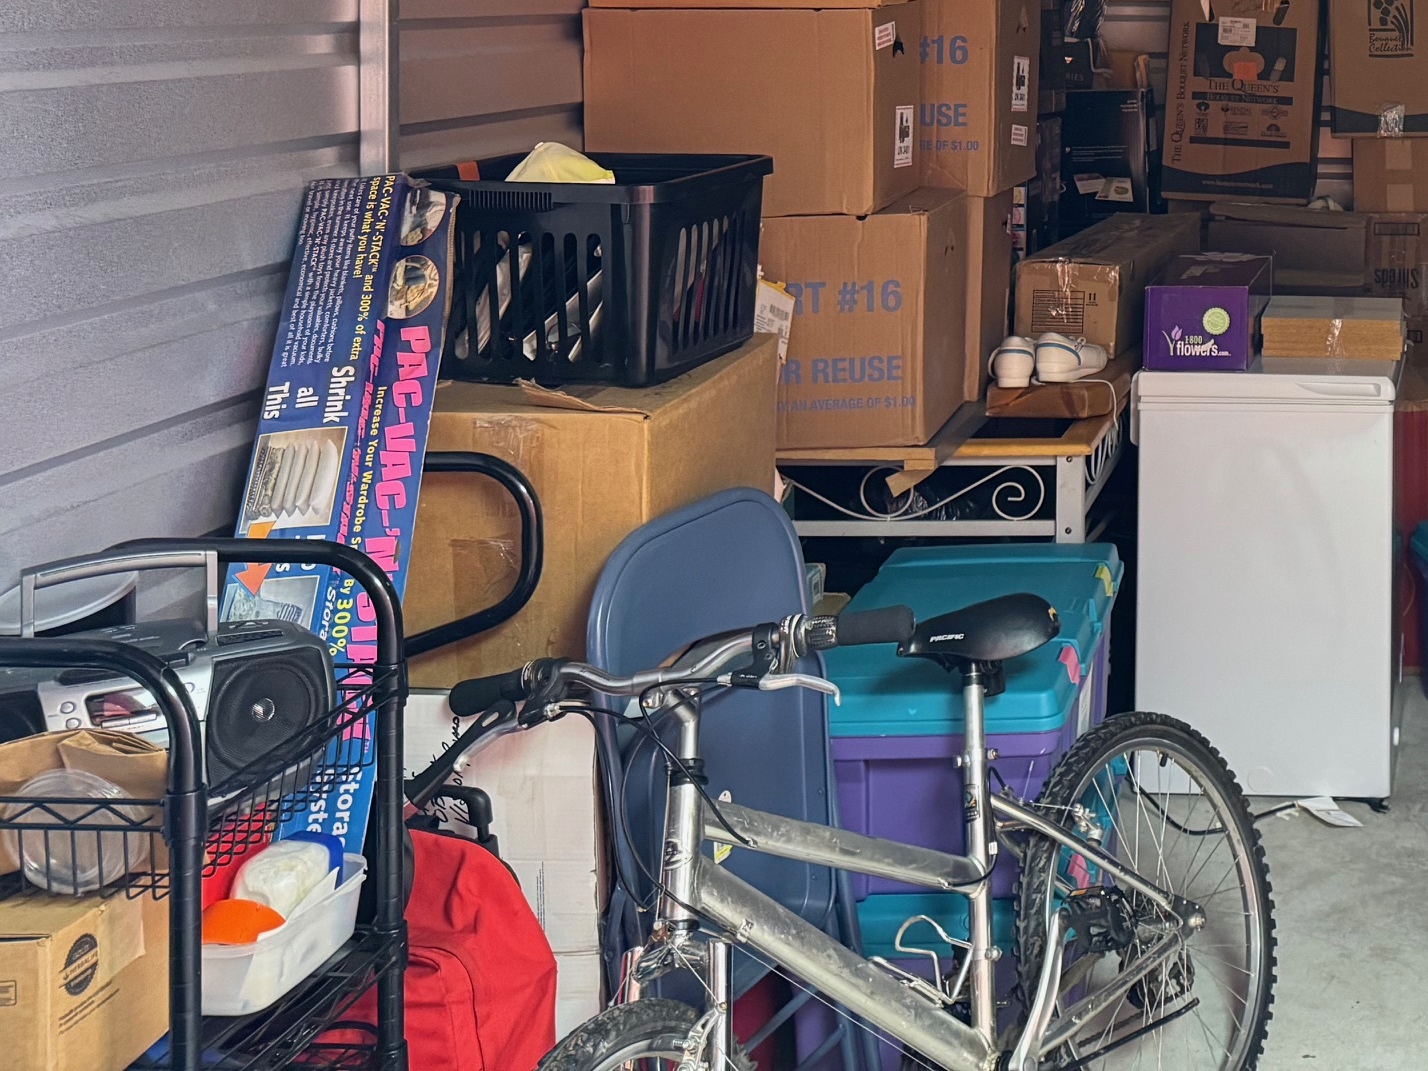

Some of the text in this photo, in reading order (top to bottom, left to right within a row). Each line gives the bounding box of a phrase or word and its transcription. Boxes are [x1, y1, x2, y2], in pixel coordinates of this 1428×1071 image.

[1171, 21, 1190, 164] THE QUEEN'S BOUQUET NETWORK
[1208, 78, 1279, 95] THE QUEEN'S
[936, 140, 948, 151] OF
[951, 139, 979, 152] $1.00
[366, 176, 381, 199] space
[354, 196, 362, 206] care
[349, 215, 357, 227] your
[360, 211, 374, 232] what
[354, 235, 369, 251] you
[351, 253, 367, 277] have!
[361, 274, 374, 291] and
[356, 294, 371, 320] 300%
[837, 280, 903, 314] #16
[354, 324, 365, 334] of
[323, 343, 333, 362] before
[349, 336, 363, 360] extra
[811, 355, 902, 384] REUSE
[262, 381, 291, 420] This
[296, 385, 319, 409] all
[323, 365, 355, 424] Shrink
[791, 400, 808, 412] AN
[811, 398, 863, 411] AVERAGE
[866, 397, 881, 408] OF
[884, 396, 915, 409] $1.00
[369, 385, 388, 436] Increase
[364, 439, 380, 470] Your
[352, 472, 375, 532] Wardrobe
[329, 579, 355, 656] By 300%
[929, 633, 965, 643] PACIFIC
